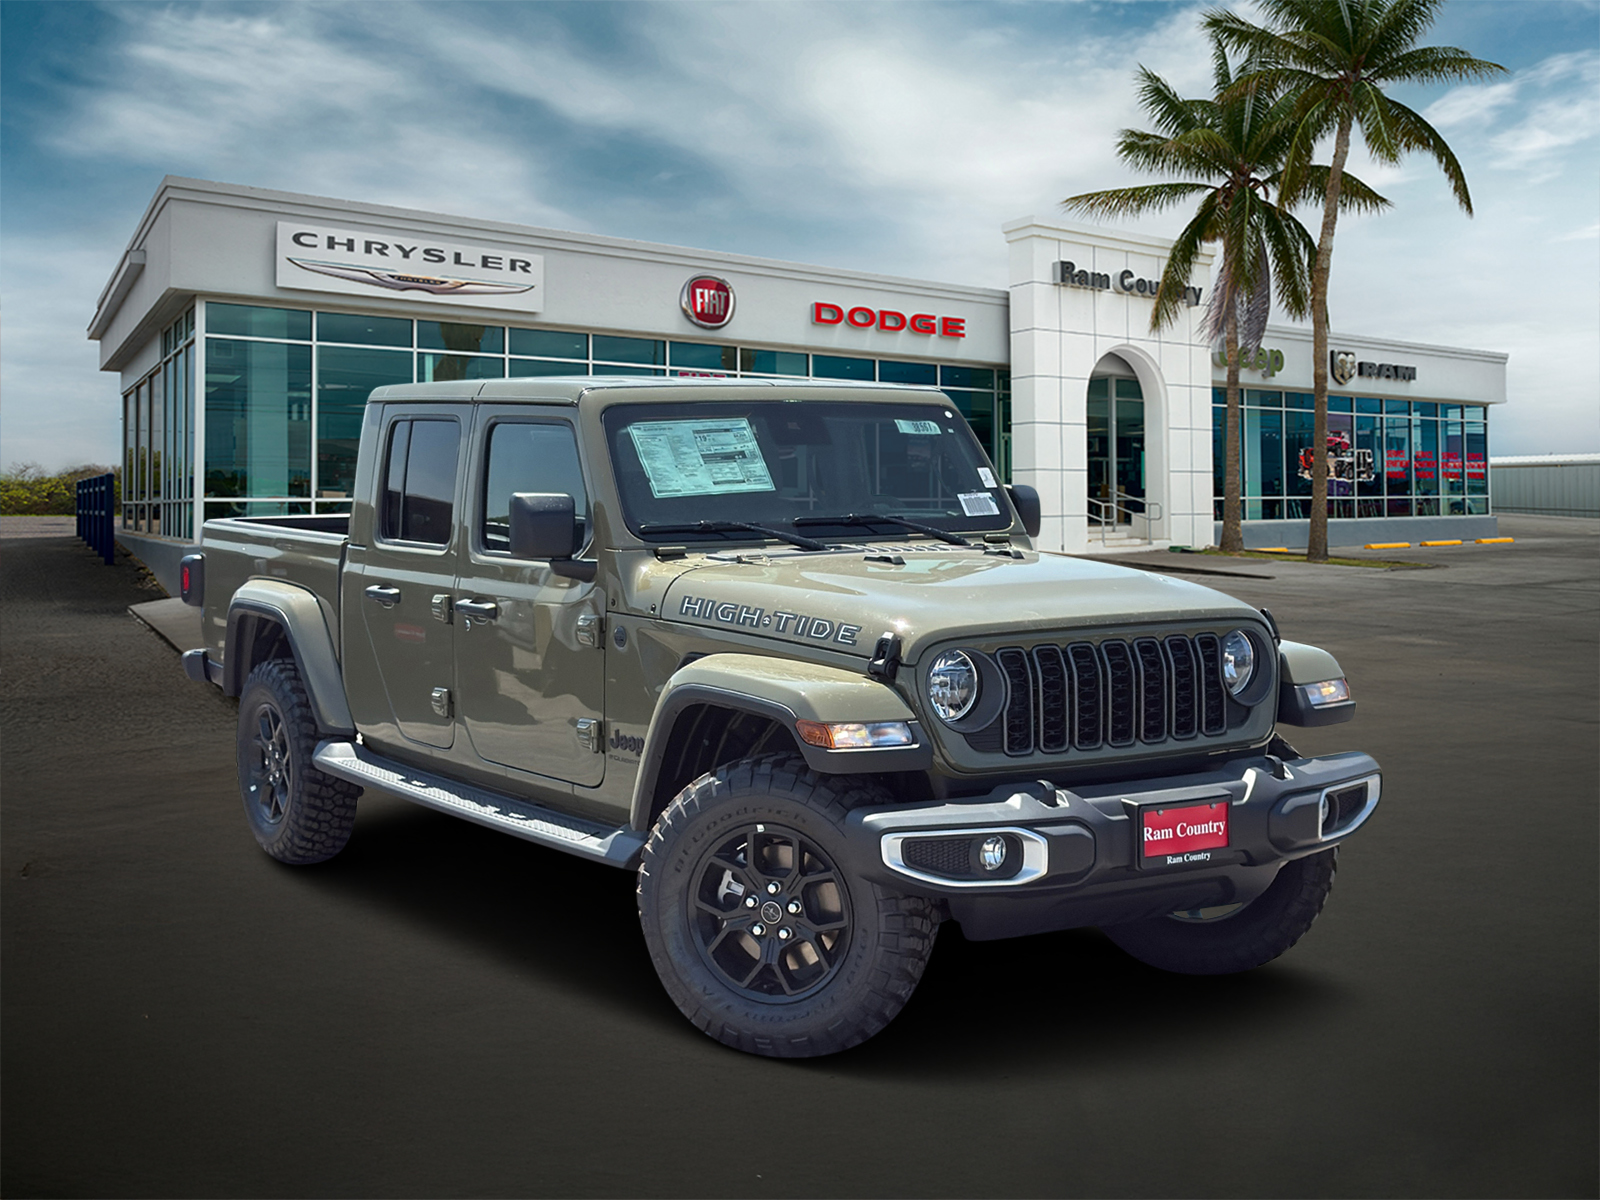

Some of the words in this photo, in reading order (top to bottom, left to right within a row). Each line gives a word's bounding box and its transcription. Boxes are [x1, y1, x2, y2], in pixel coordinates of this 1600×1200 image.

[291, 231, 533, 274] CHRYSLER
[1053, 260, 1111, 290] Ram
[1113, 269, 1203, 307] Coury
[694, 287, 728, 316] FIAT
[811, 301, 967, 339] DODGE
[1357, 361, 1417, 380] RAM
[679, 595, 765, 629] HIGH
[773, 610, 863, 647] TIDE
[610, 729, 645, 757] Jeep
[1143, 827, 1173, 841] Ram
[1176, 820, 1226, 837] Country
[1167, 856, 1182, 864] Ram
[1184, 852, 1211, 862] Country
